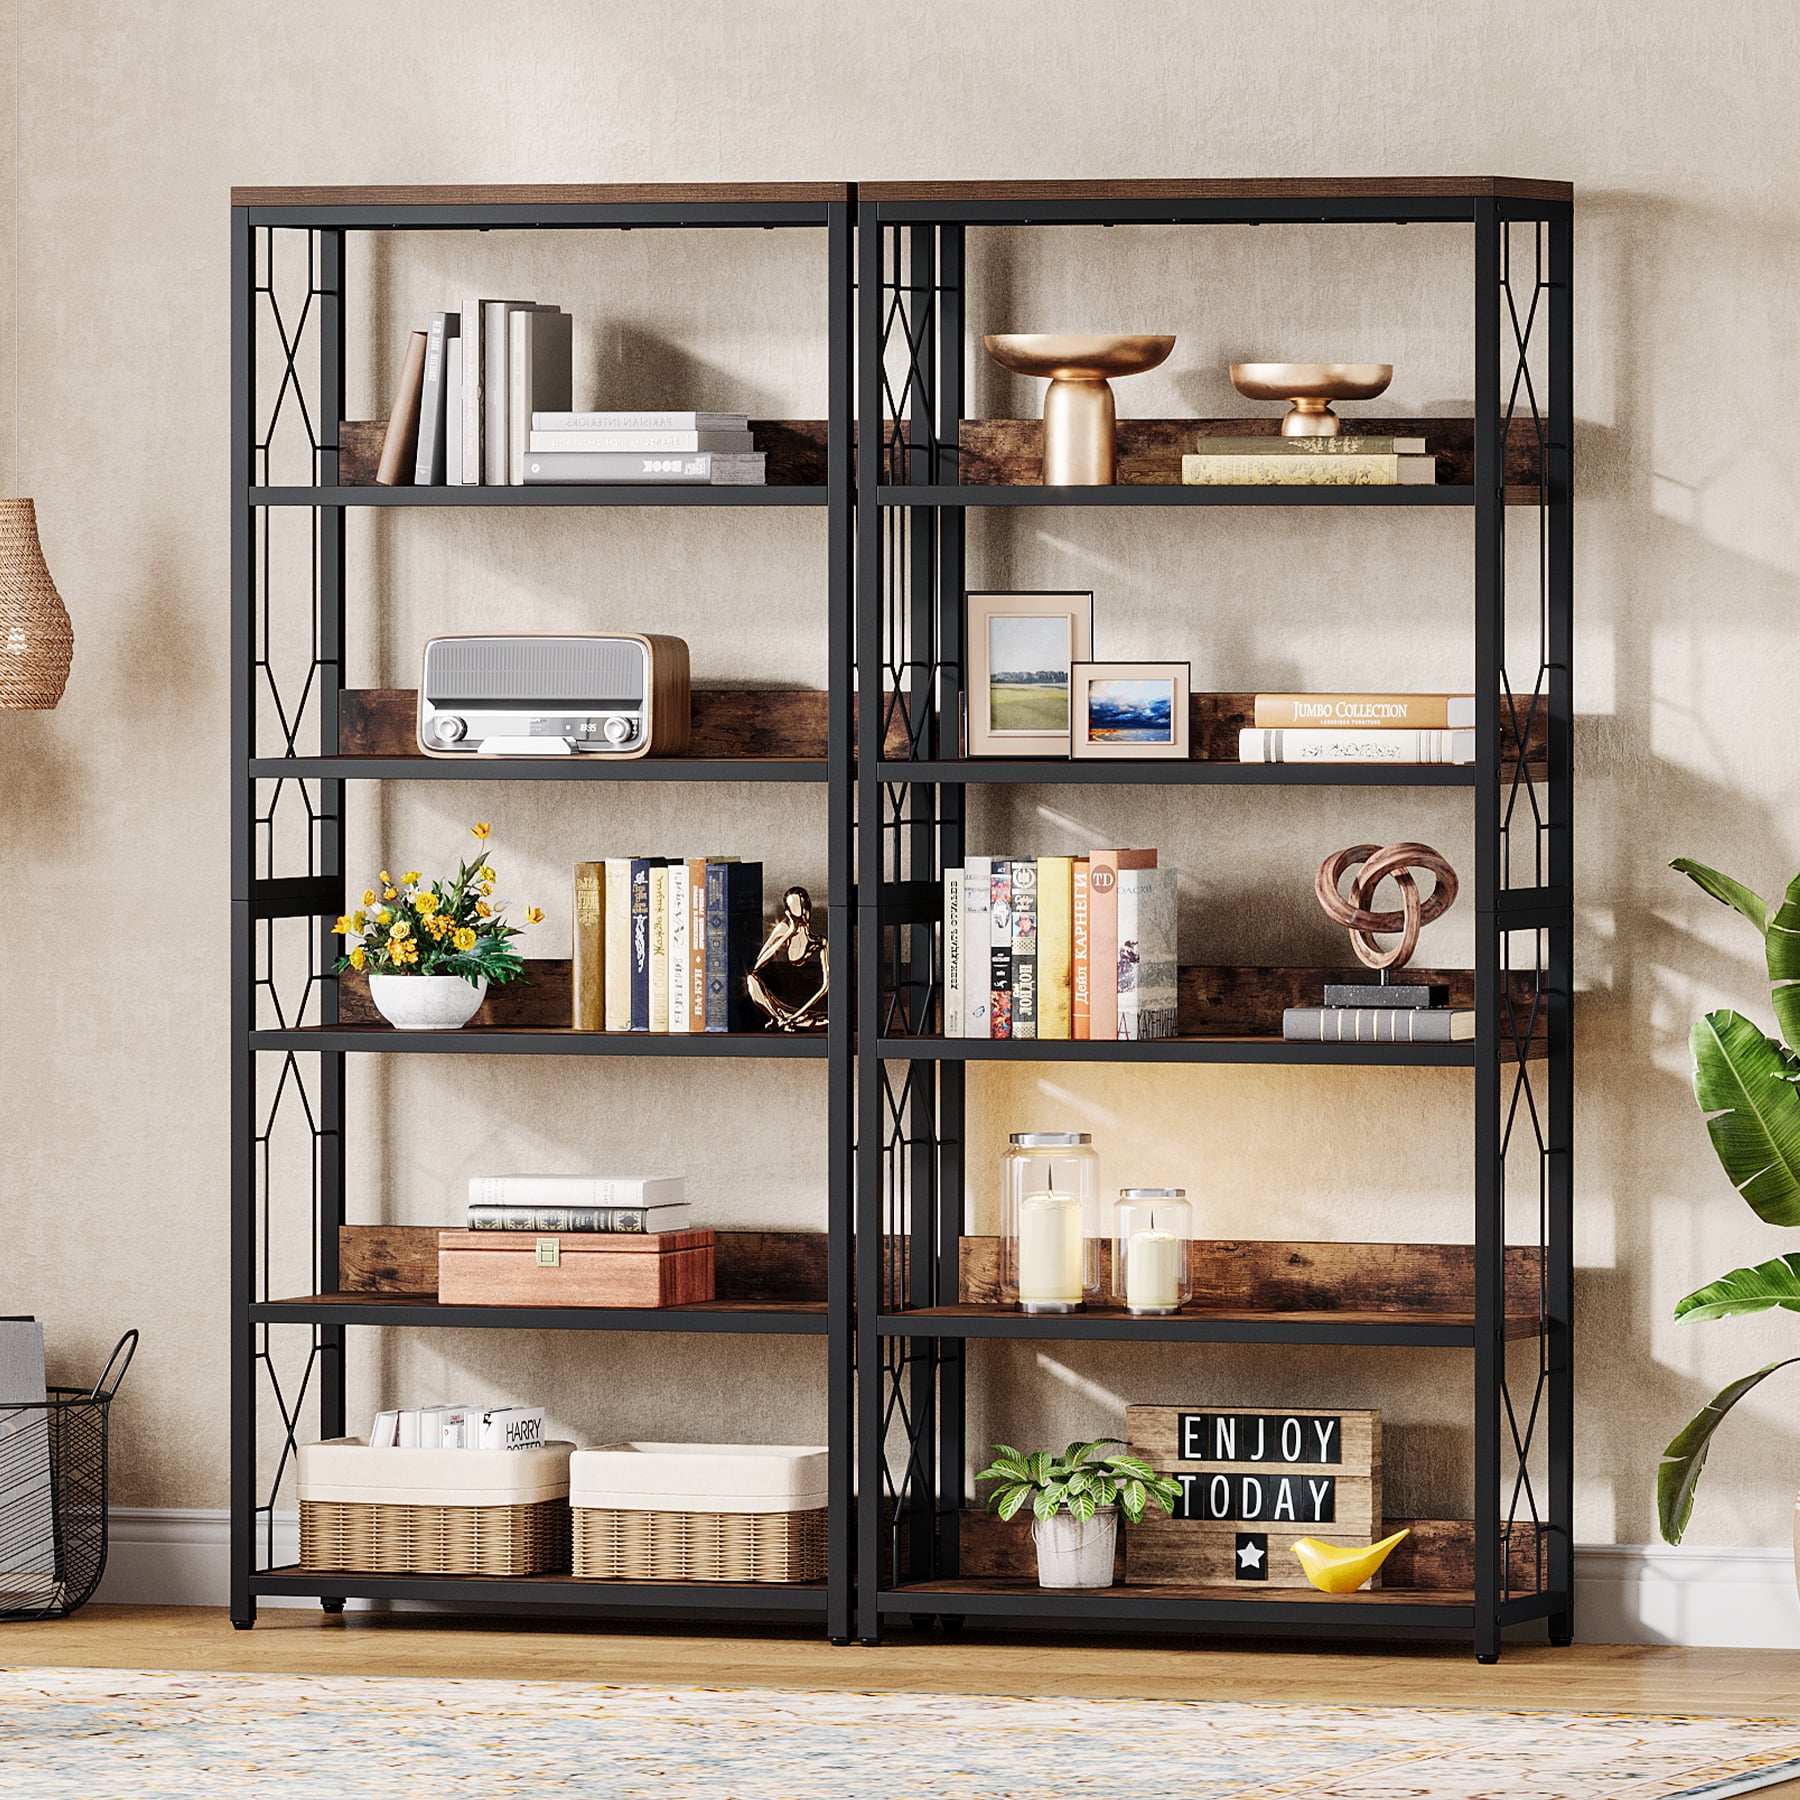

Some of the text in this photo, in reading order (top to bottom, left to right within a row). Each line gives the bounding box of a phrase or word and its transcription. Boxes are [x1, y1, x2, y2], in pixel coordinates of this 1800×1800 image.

[1293, 701, 1408, 722] JUMBO COLLECTION
[1092, 872, 1114, 887] TD
[1074, 873, 1089, 1005] Дейл КАРНЕГИ
[505, 1417, 541, 1443] HARRY
[1185, 1416, 1335, 1463] ENJOY
[1177, 1475, 1330, 1521] TODAY
